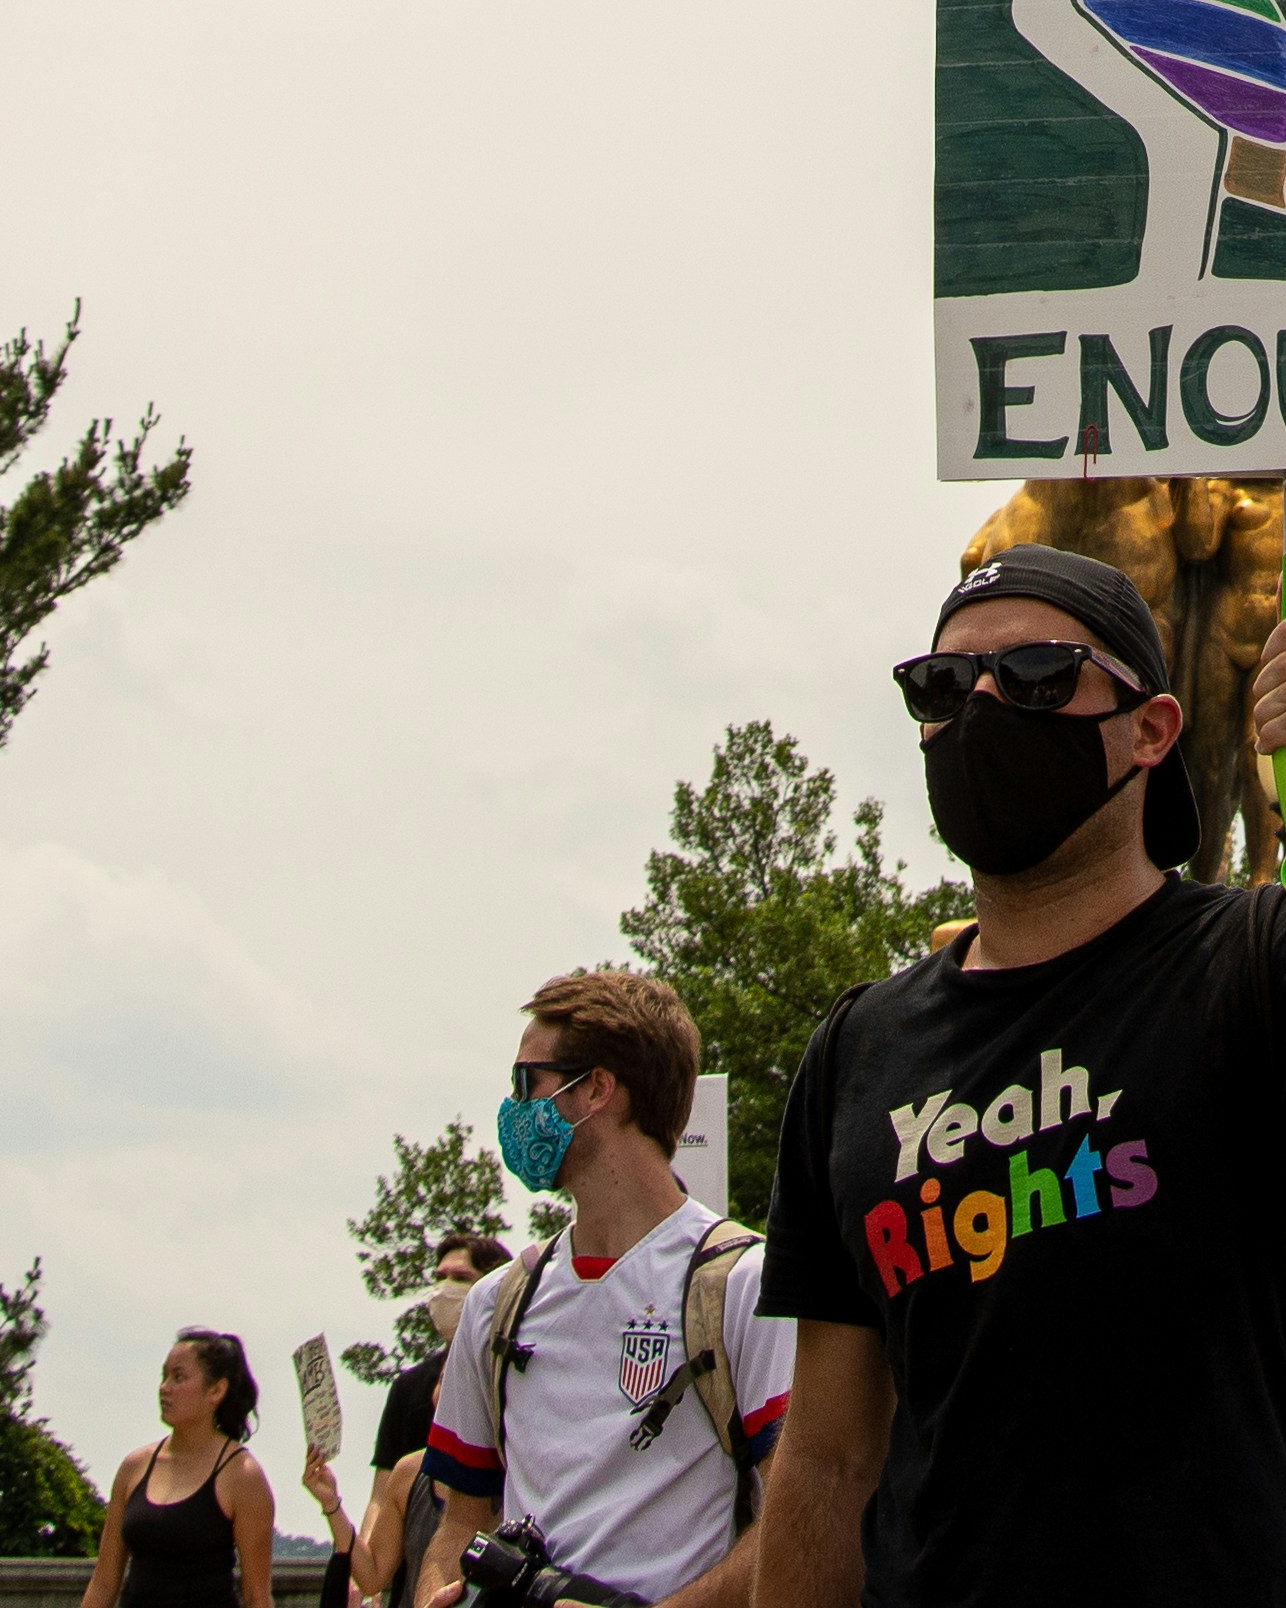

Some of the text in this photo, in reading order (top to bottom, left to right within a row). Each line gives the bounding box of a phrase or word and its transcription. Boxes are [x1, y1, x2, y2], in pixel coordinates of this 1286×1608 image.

[889, 1048, 1123, 1183] Yeah,
[864, 1133, 1158, 1299] Rights
[626, 1337, 666, 1364] USA
